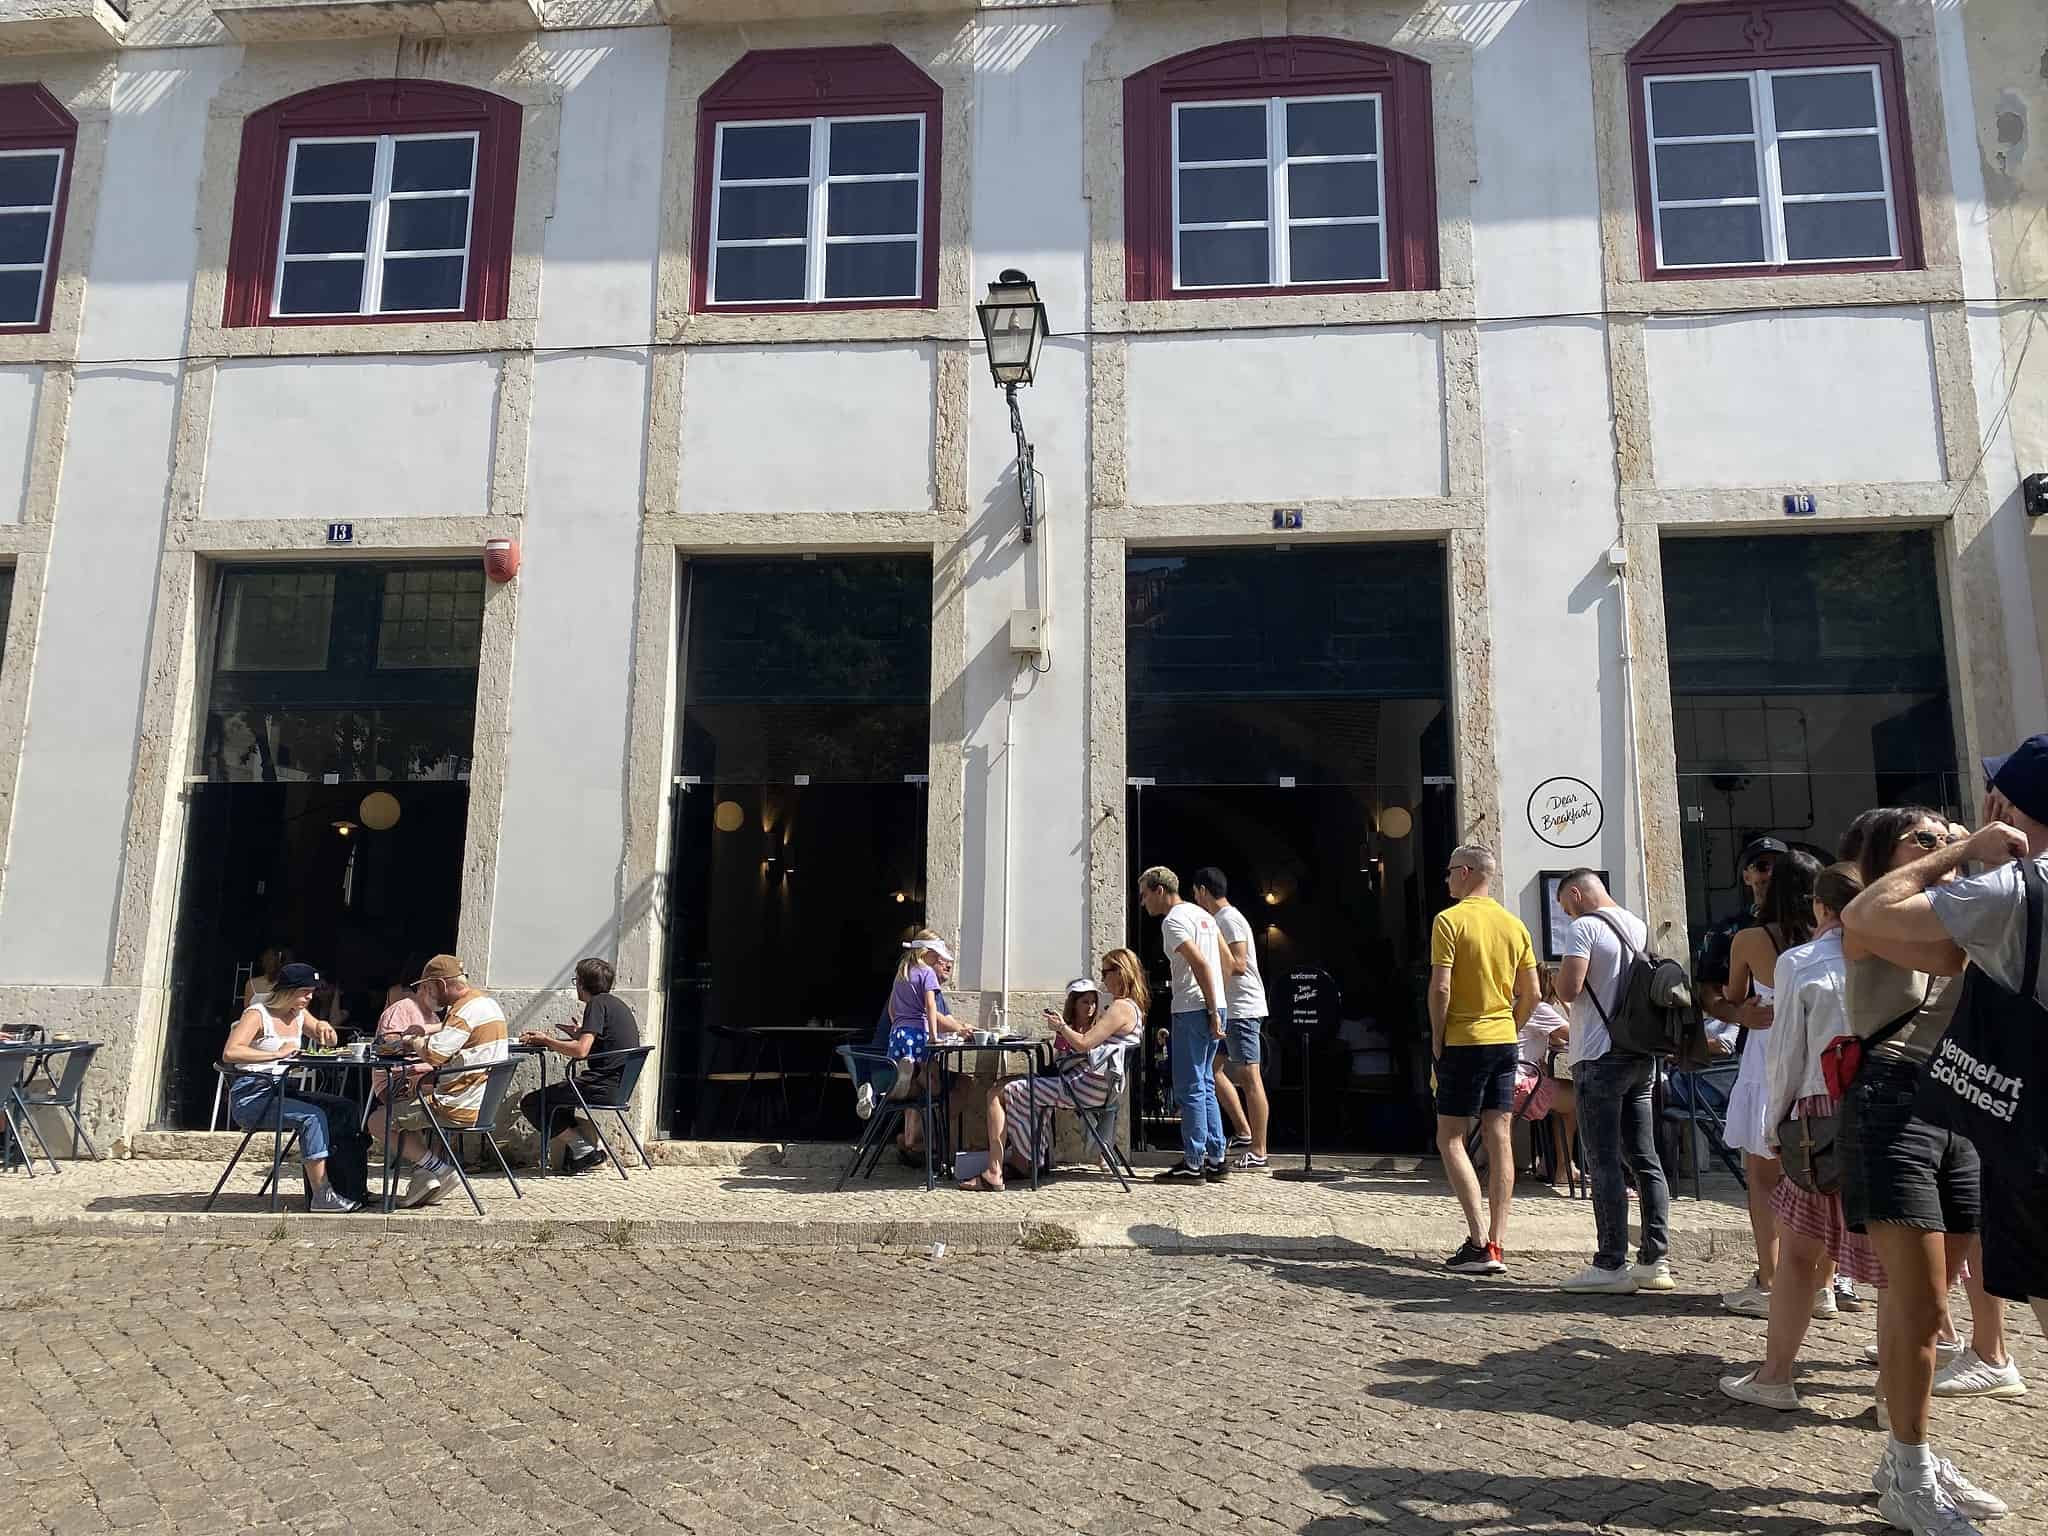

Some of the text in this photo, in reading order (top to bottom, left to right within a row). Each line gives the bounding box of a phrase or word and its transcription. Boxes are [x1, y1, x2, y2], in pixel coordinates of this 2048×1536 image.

[1793, 495, 1810, 512] 16
[333, 525, 347, 540] 13
[1550, 794, 1579, 810] Dear
[1541, 802, 1594, 831] Breakfast
